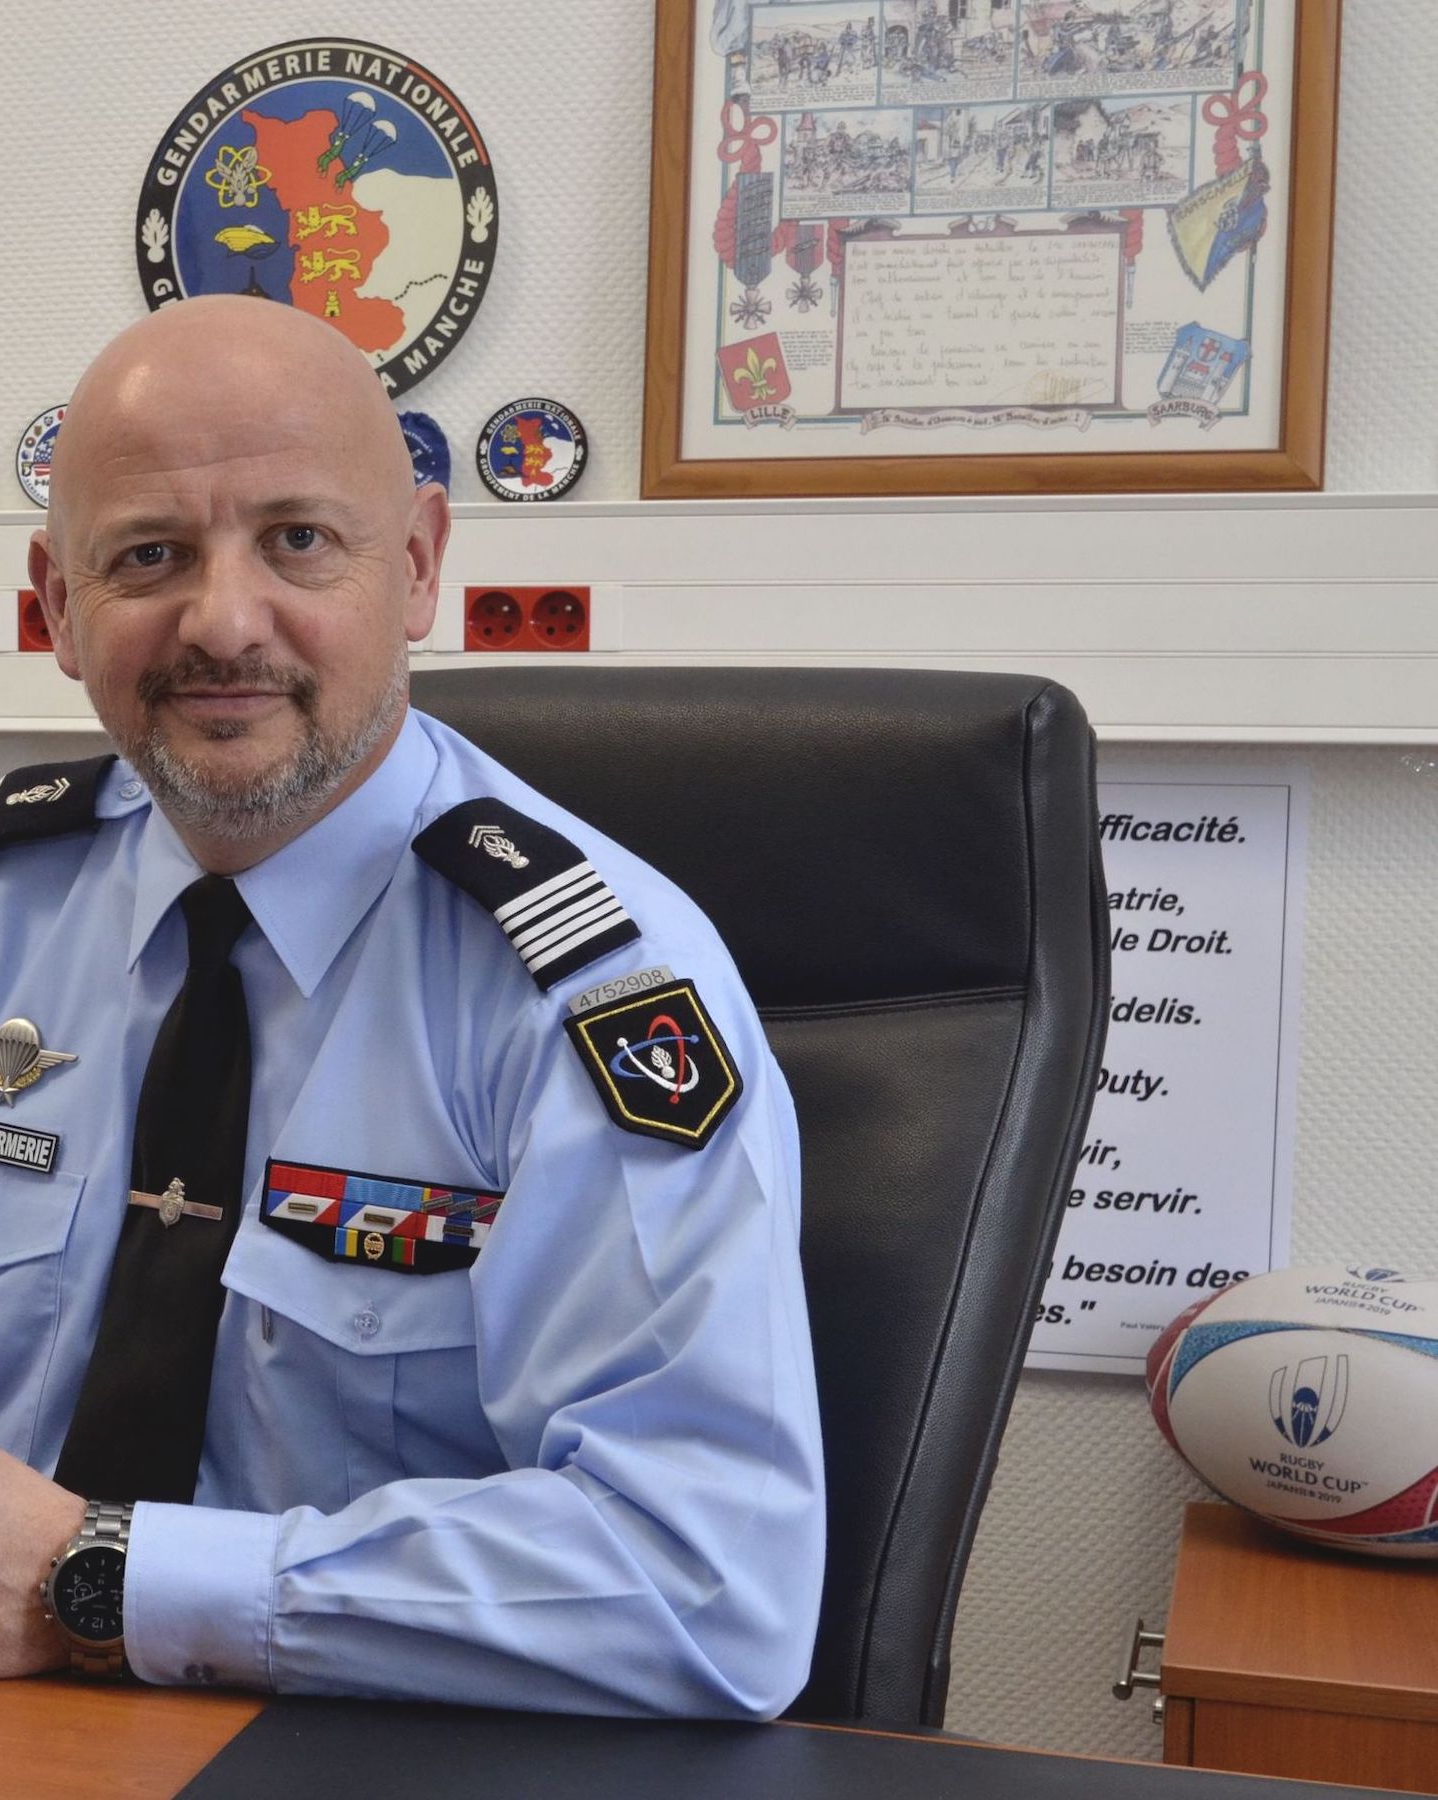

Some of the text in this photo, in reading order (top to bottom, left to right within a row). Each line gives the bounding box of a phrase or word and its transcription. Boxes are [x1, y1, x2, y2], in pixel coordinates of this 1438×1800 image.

[156, 50, 479, 187] GENDARMERIE NATIONALE
[403, 259, 485, 376] MANCHE
[486, 402, 542, 434] GENDARMERIE
[749, 405, 791, 420] LILLE
[1152, 401, 1214, 420] SAARBURG
[479, 458, 520, 500] GROUPEMENT
[538, 490, 550, 499] LA
[551, 463, 580, 494] MANCHE
[1099, 814, 1246, 843] fficacité.
[1108, 887, 1185, 916] atrie,
[1111, 927, 1232, 954] le Droit.
[578, 969, 666, 1009] 4752908
[1111, 995, 1202, 1025] delis.
[1093, 1188, 1202, 1214] servir.
[1062, 1254, 1177, 1287] besoin
[1186, 1262, 1250, 1289] des
[1305, 1285, 1375, 1300] WORLD
[1249, 1457, 1318, 1486] WORLD
[1279, 1452, 1325, 1471] RUGBY
